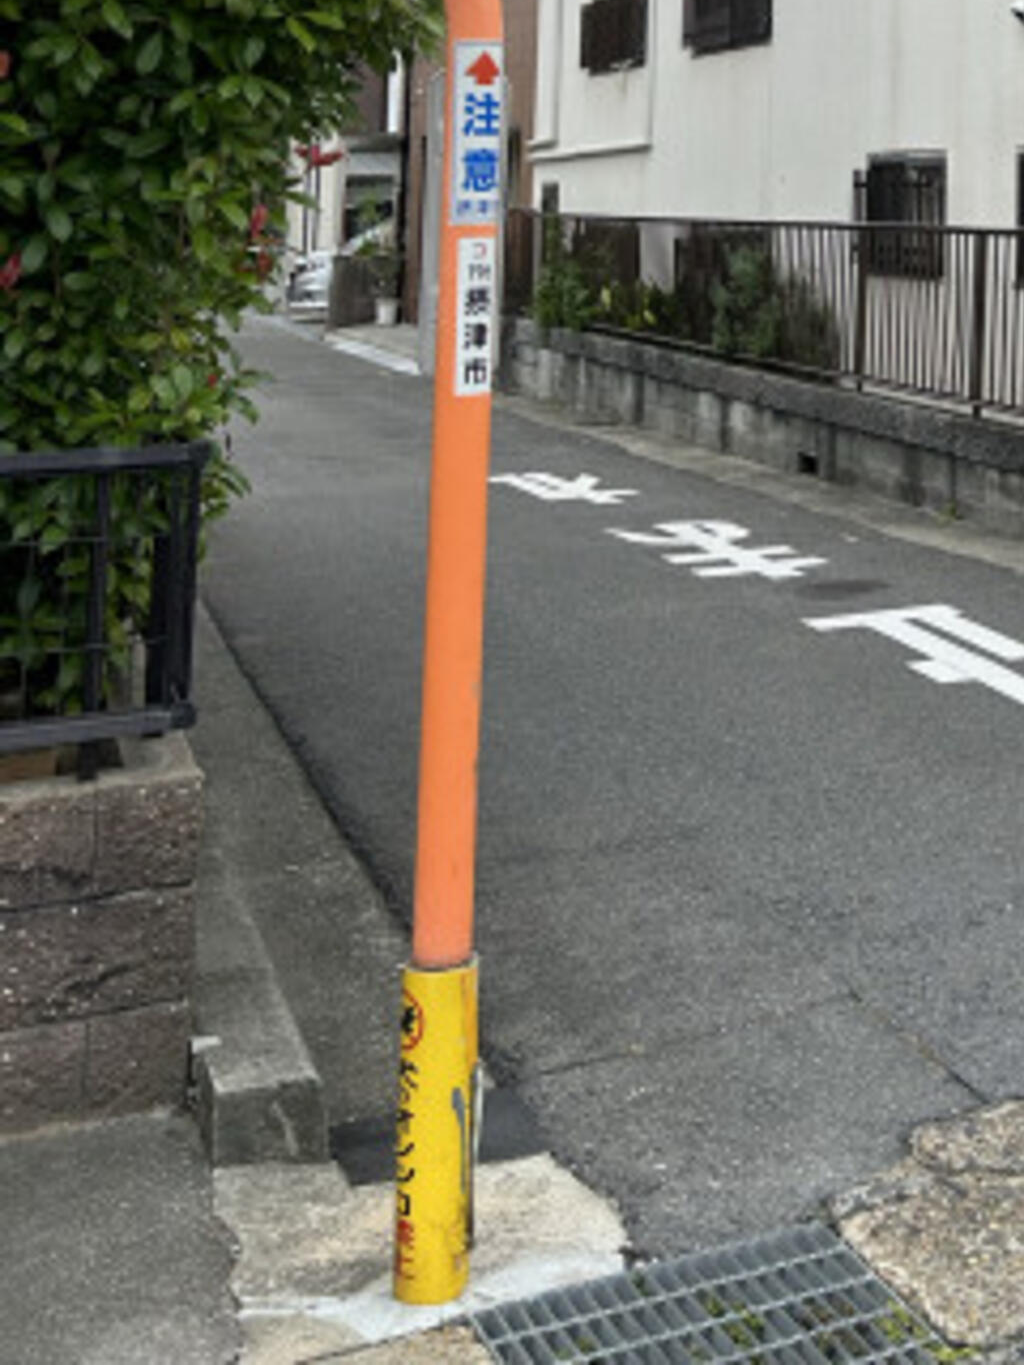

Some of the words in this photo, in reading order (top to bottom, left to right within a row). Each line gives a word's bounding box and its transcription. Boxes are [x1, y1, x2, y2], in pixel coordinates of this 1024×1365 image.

[462, 93, 500, 192] 注意
[463, 286, 490, 385] 摂津市
